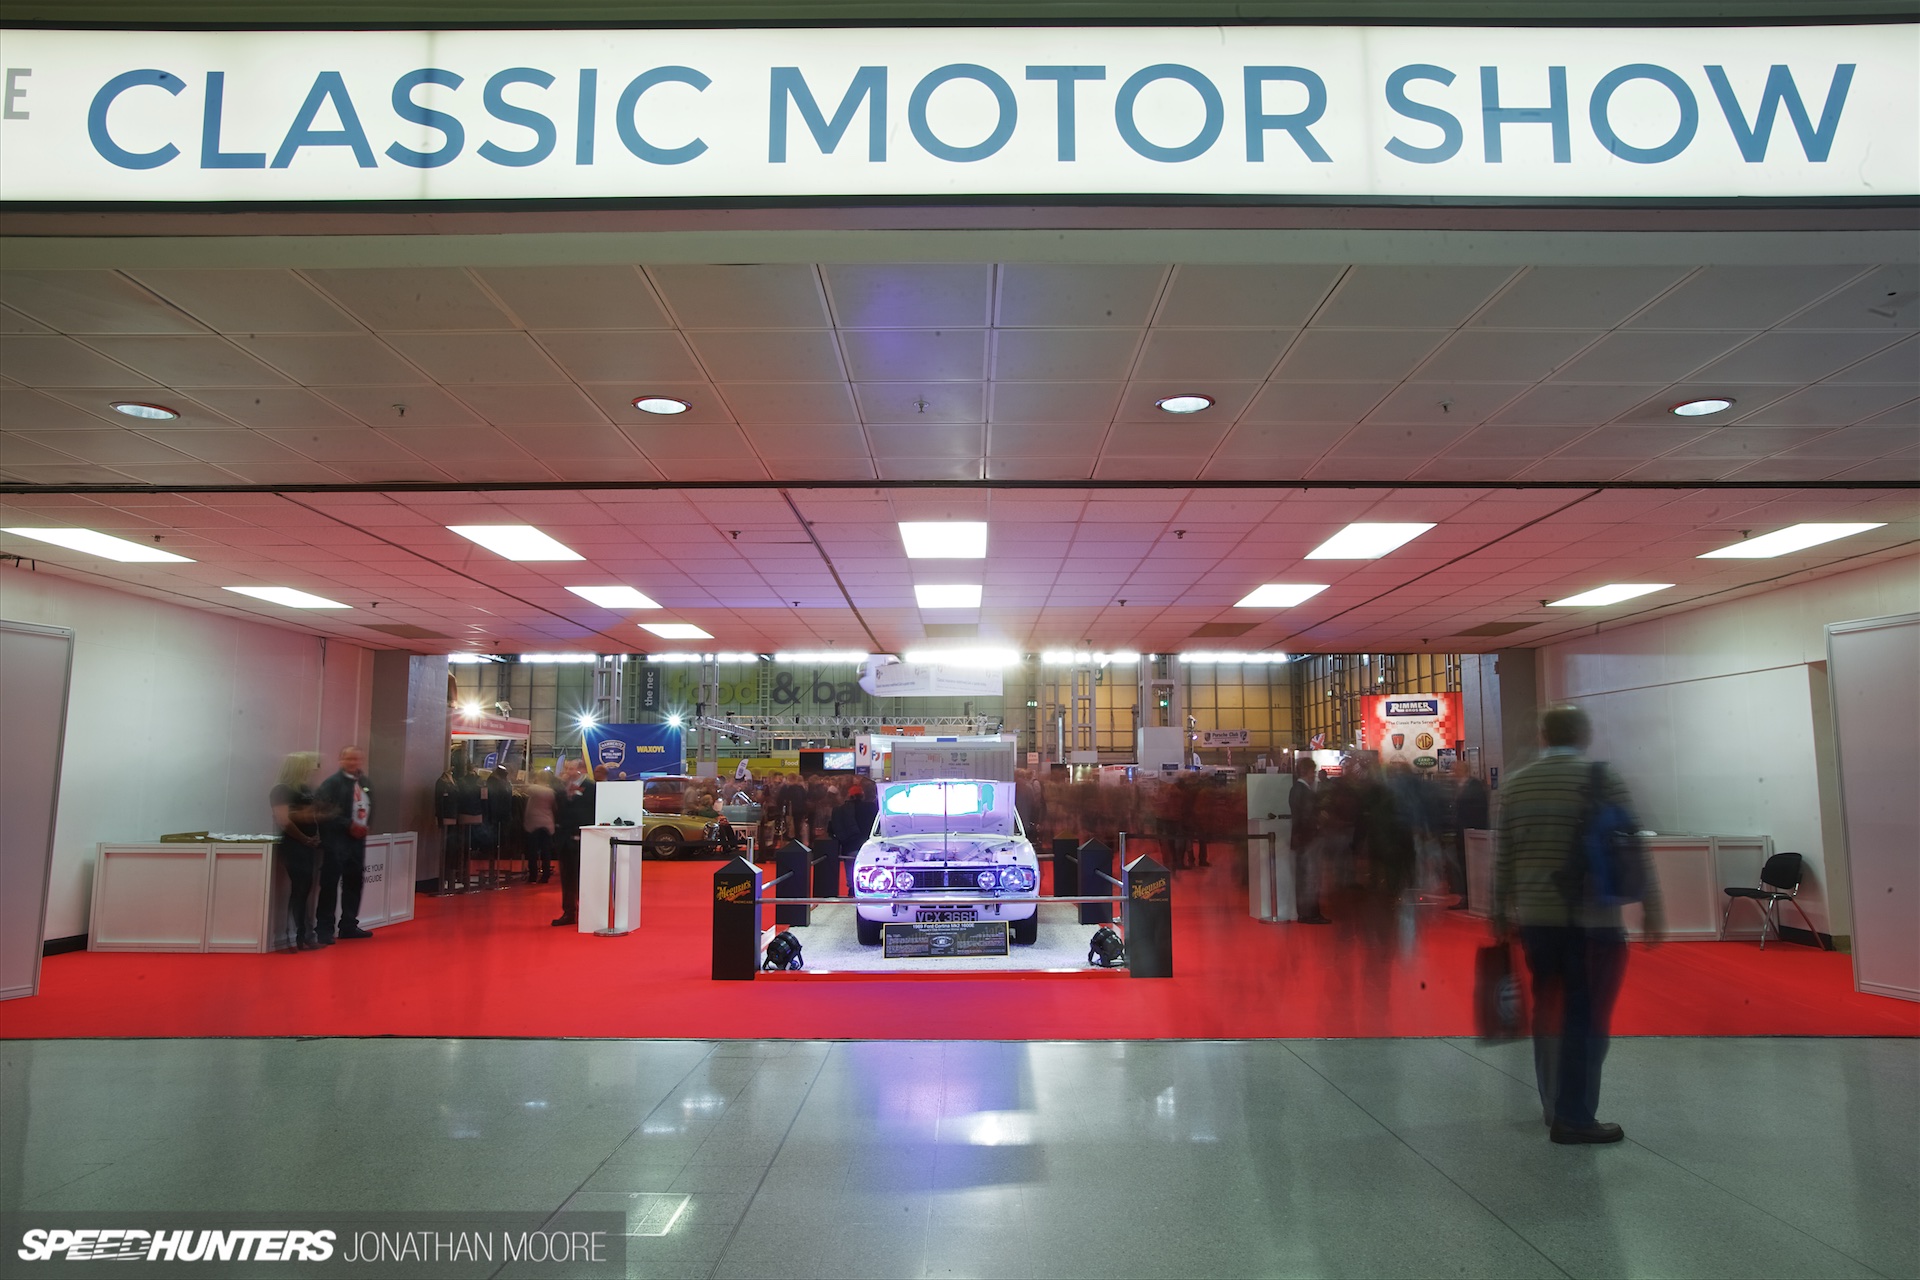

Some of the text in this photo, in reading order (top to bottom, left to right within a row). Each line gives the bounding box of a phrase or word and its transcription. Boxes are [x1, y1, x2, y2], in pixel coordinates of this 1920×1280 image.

[3, 63, 1857, 170] E CLASSIC MOTOR SHOW
[645, 671, 654, 707] the nec
[773, 671, 801, 705] &
[1390, 702, 1433, 713] RIMMER
[1417, 735, 1431, 748] MG
[372, 863, 384, 872] YOUR
[917, 911, 978, 922] VCX 366H
